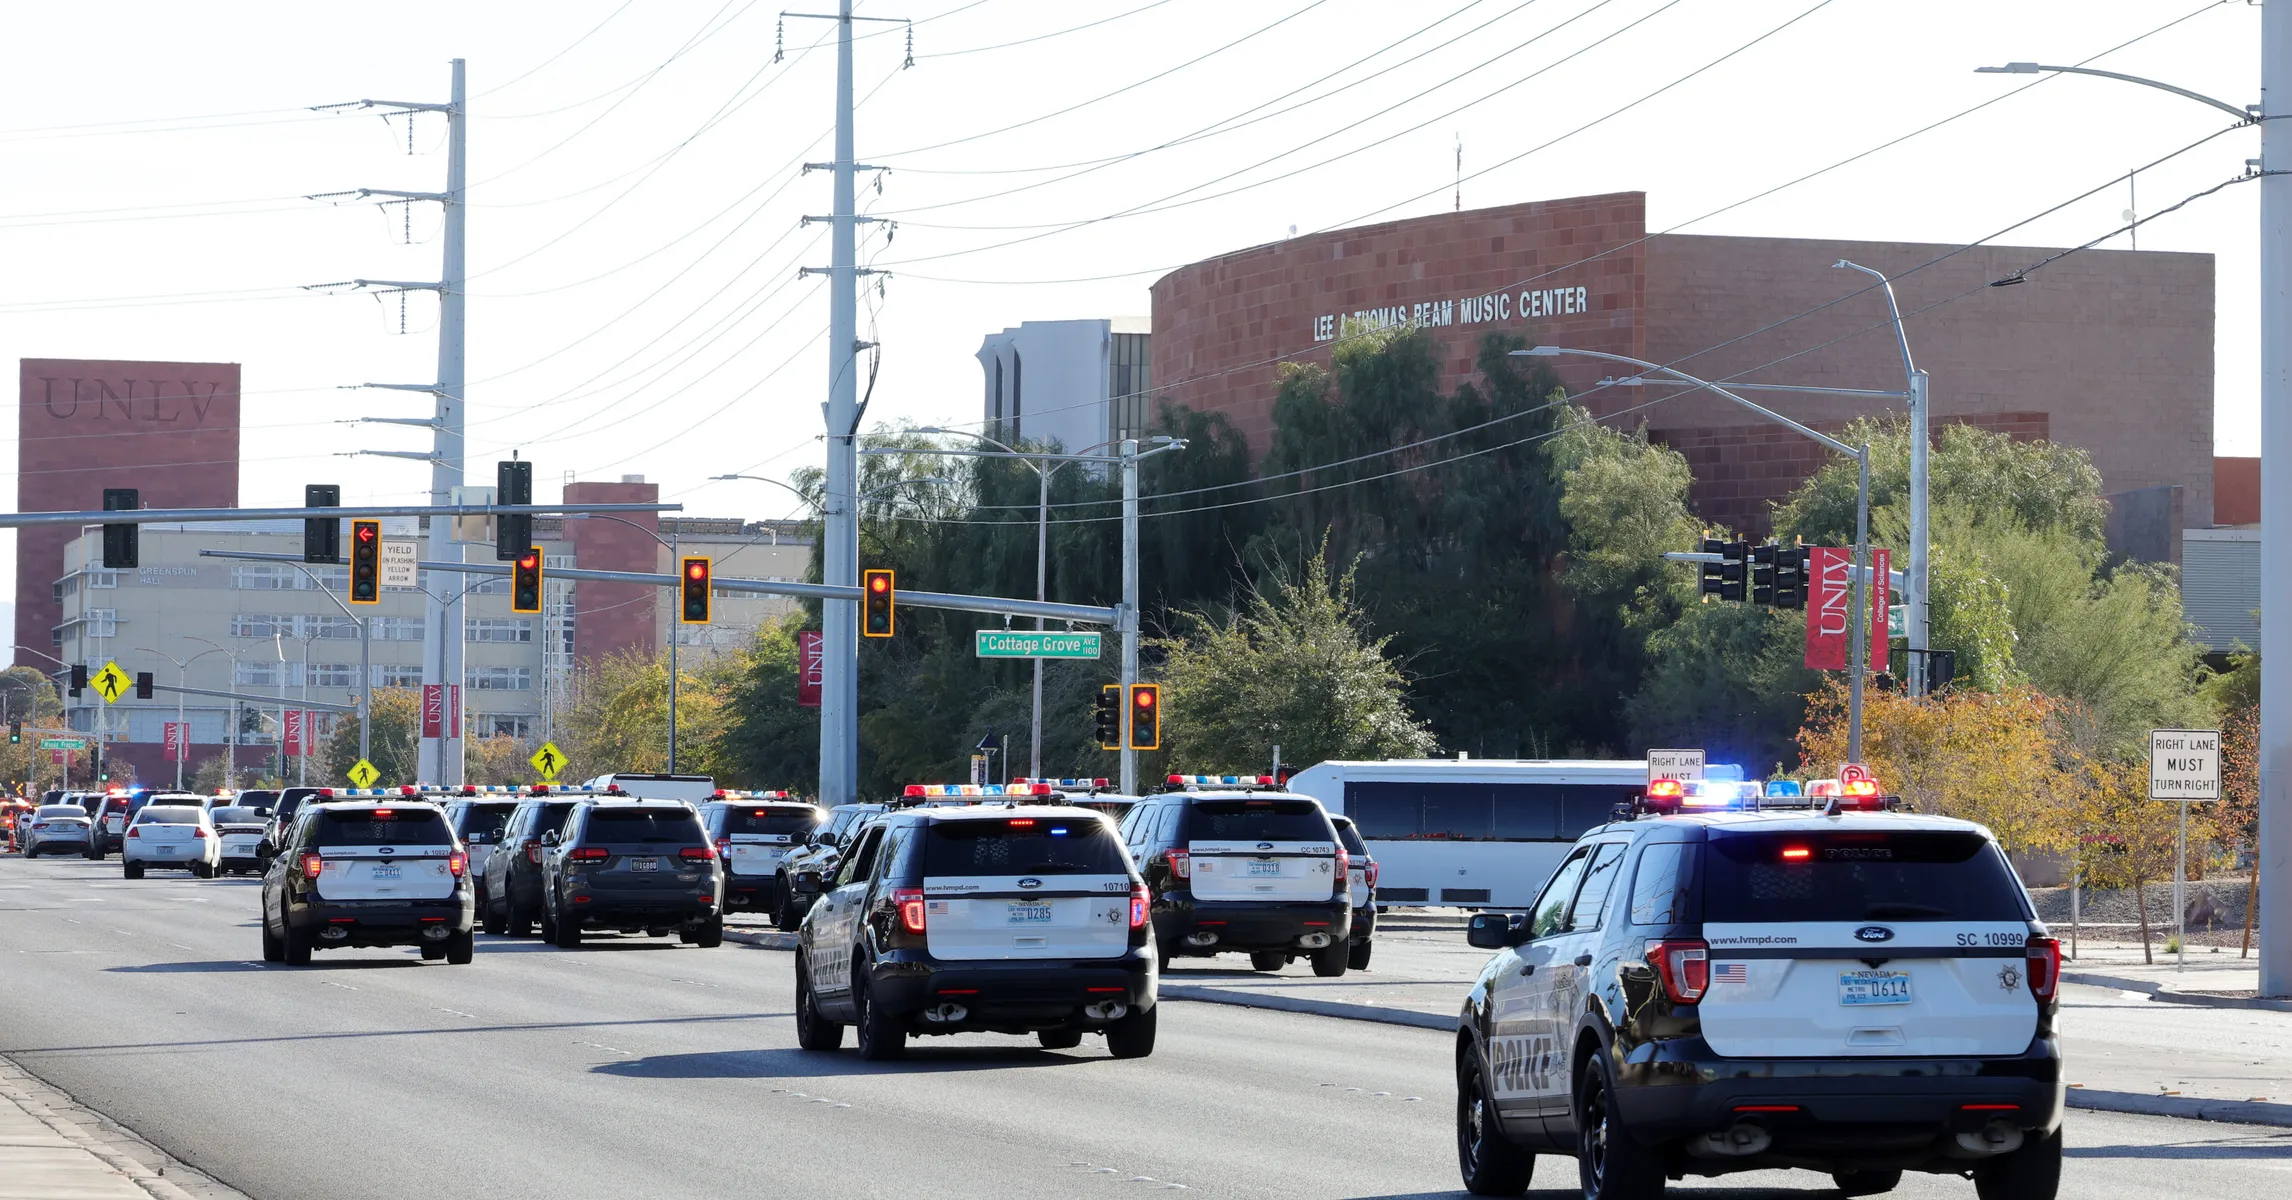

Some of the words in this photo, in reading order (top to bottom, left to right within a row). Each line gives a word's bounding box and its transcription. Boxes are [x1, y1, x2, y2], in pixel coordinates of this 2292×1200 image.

[1314, 315, 1334, 341] LEE
[1414, 299, 1453, 329] BEAM
[1460, 293, 1510, 324] MUSIC
[1519, 286, 1587, 317] CENTER
[38, 377, 221, 422] UNLV
[388, 546, 412, 554] YIELD
[139, 567, 197, 576] GREENSPUN
[1820, 549, 1848, 638] UNLV
[1878, 586, 1884, 594] of
[1876, 596, 1886, 623] College
[989, 636, 1039, 654] Cottage
[1043, 636, 1080, 651] Grove
[1082, 638, 1096, 646] AVE
[808, 632, 824, 687] UNLV
[429, 686, 441, 724] UNLV
[288, 711, 301, 744] UNLV
[168, 723, 178, 750] UNLV
[2156, 739, 2184, 750] RIGHT
[2190, 740, 2216, 750] LANE
[1652, 758, 1676, 766] RIGHT
[1680, 758, 1700, 766] LANE
[2168, 758, 2204, 772] MUST
[2155, 780, 2182, 790] TURN
[2184, 780, 2216, 790] RIGHT
[1262, 864, 1280, 872] 0318
[1022, 879, 1038, 887] Ford
[1103, 882, 1129, 890] 10710
[1028, 908, 1050, 920] 0285
[1710, 935, 1797, 946] www.lvmpd.com
[1862, 928, 1886, 940] Ford
[1956, 933, 1978, 946] SC
[1984, 933, 2023, 946] 10999
[1871, 980, 1907, 997] 0614
[1493, 1038, 1551, 1092] POLICE
